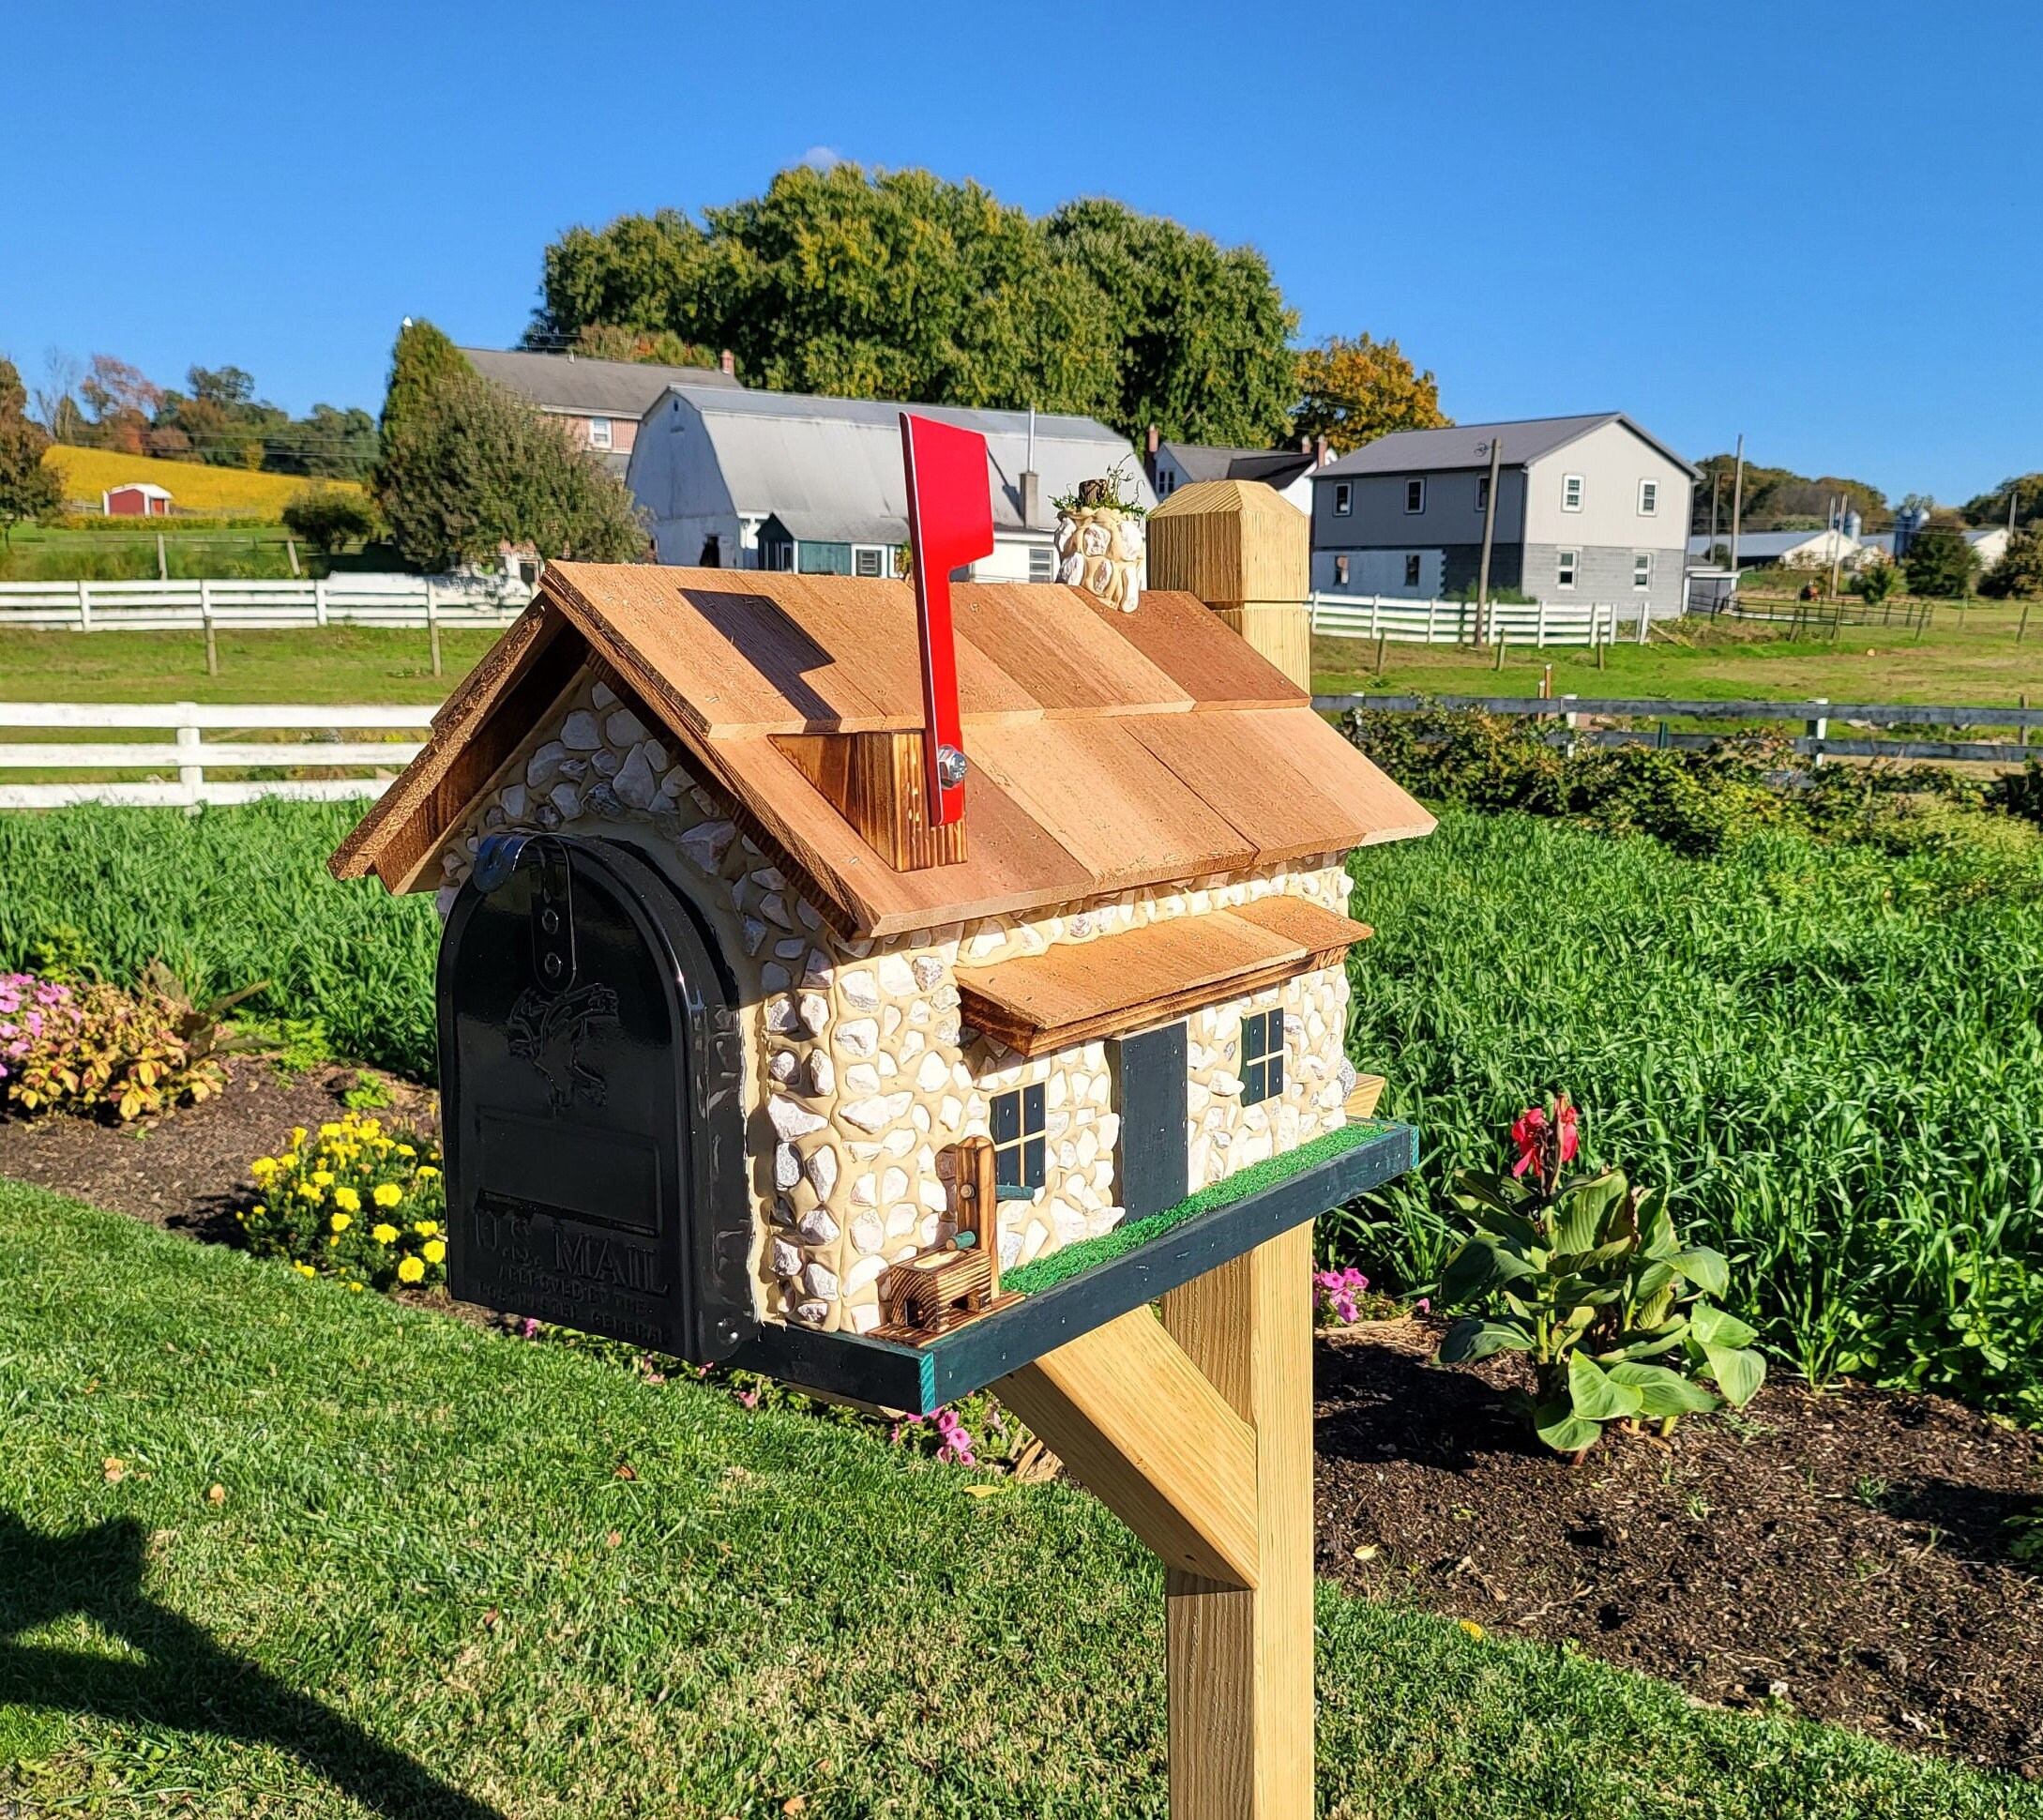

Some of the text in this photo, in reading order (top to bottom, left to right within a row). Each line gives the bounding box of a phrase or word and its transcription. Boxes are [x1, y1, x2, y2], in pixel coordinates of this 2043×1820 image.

[475, 1209, 669, 1295] U.S. MAIL
[498, 1265, 584, 1304] APPROVED
